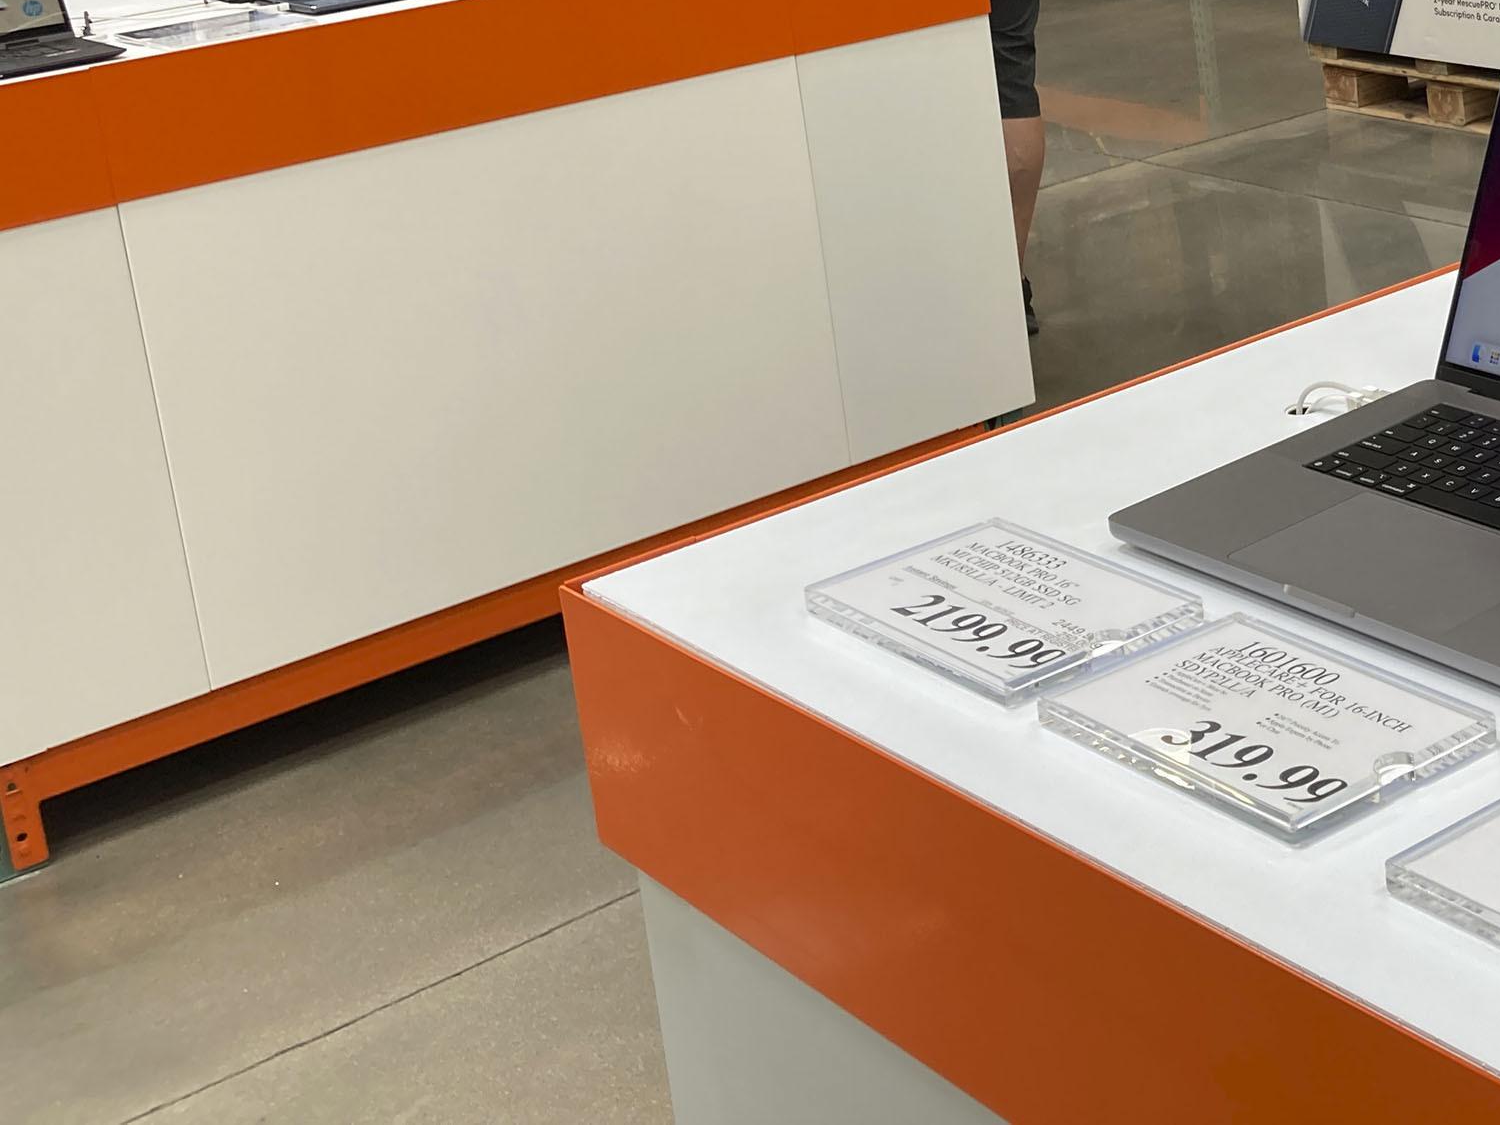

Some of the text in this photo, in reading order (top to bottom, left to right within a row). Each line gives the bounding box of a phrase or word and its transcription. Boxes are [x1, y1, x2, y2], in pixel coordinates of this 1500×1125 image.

[1434, 7, 1475, 20] Subscription
[966, 542, 1028, 572] MACBOOK
[1026, 566, 1058, 584] PRO
[971, 557, 1001, 575] CHIP
[998, 569, 1036, 588] 512GB
[1033, 581, 1061, 598] SSD
[1058, 593, 1082, 606] SG
[1003, 586, 1044, 606] LIMIT
[890, 595, 1066, 670] 2199.99
[1175, 660, 1257, 698] SDYP2LL/A
[1193, 652, 1272, 690] MACBOOK
[1270, 684, 1306, 703] PRO
[1236, 641, 1340, 686] 1601600
[1209, 646, 1309, 688] APPLECARE+
[1310, 687, 1345, 706] FOR
[1345, 702, 1414, 733] 16-INCH
[1161, 720, 1348, 803] 319.99
